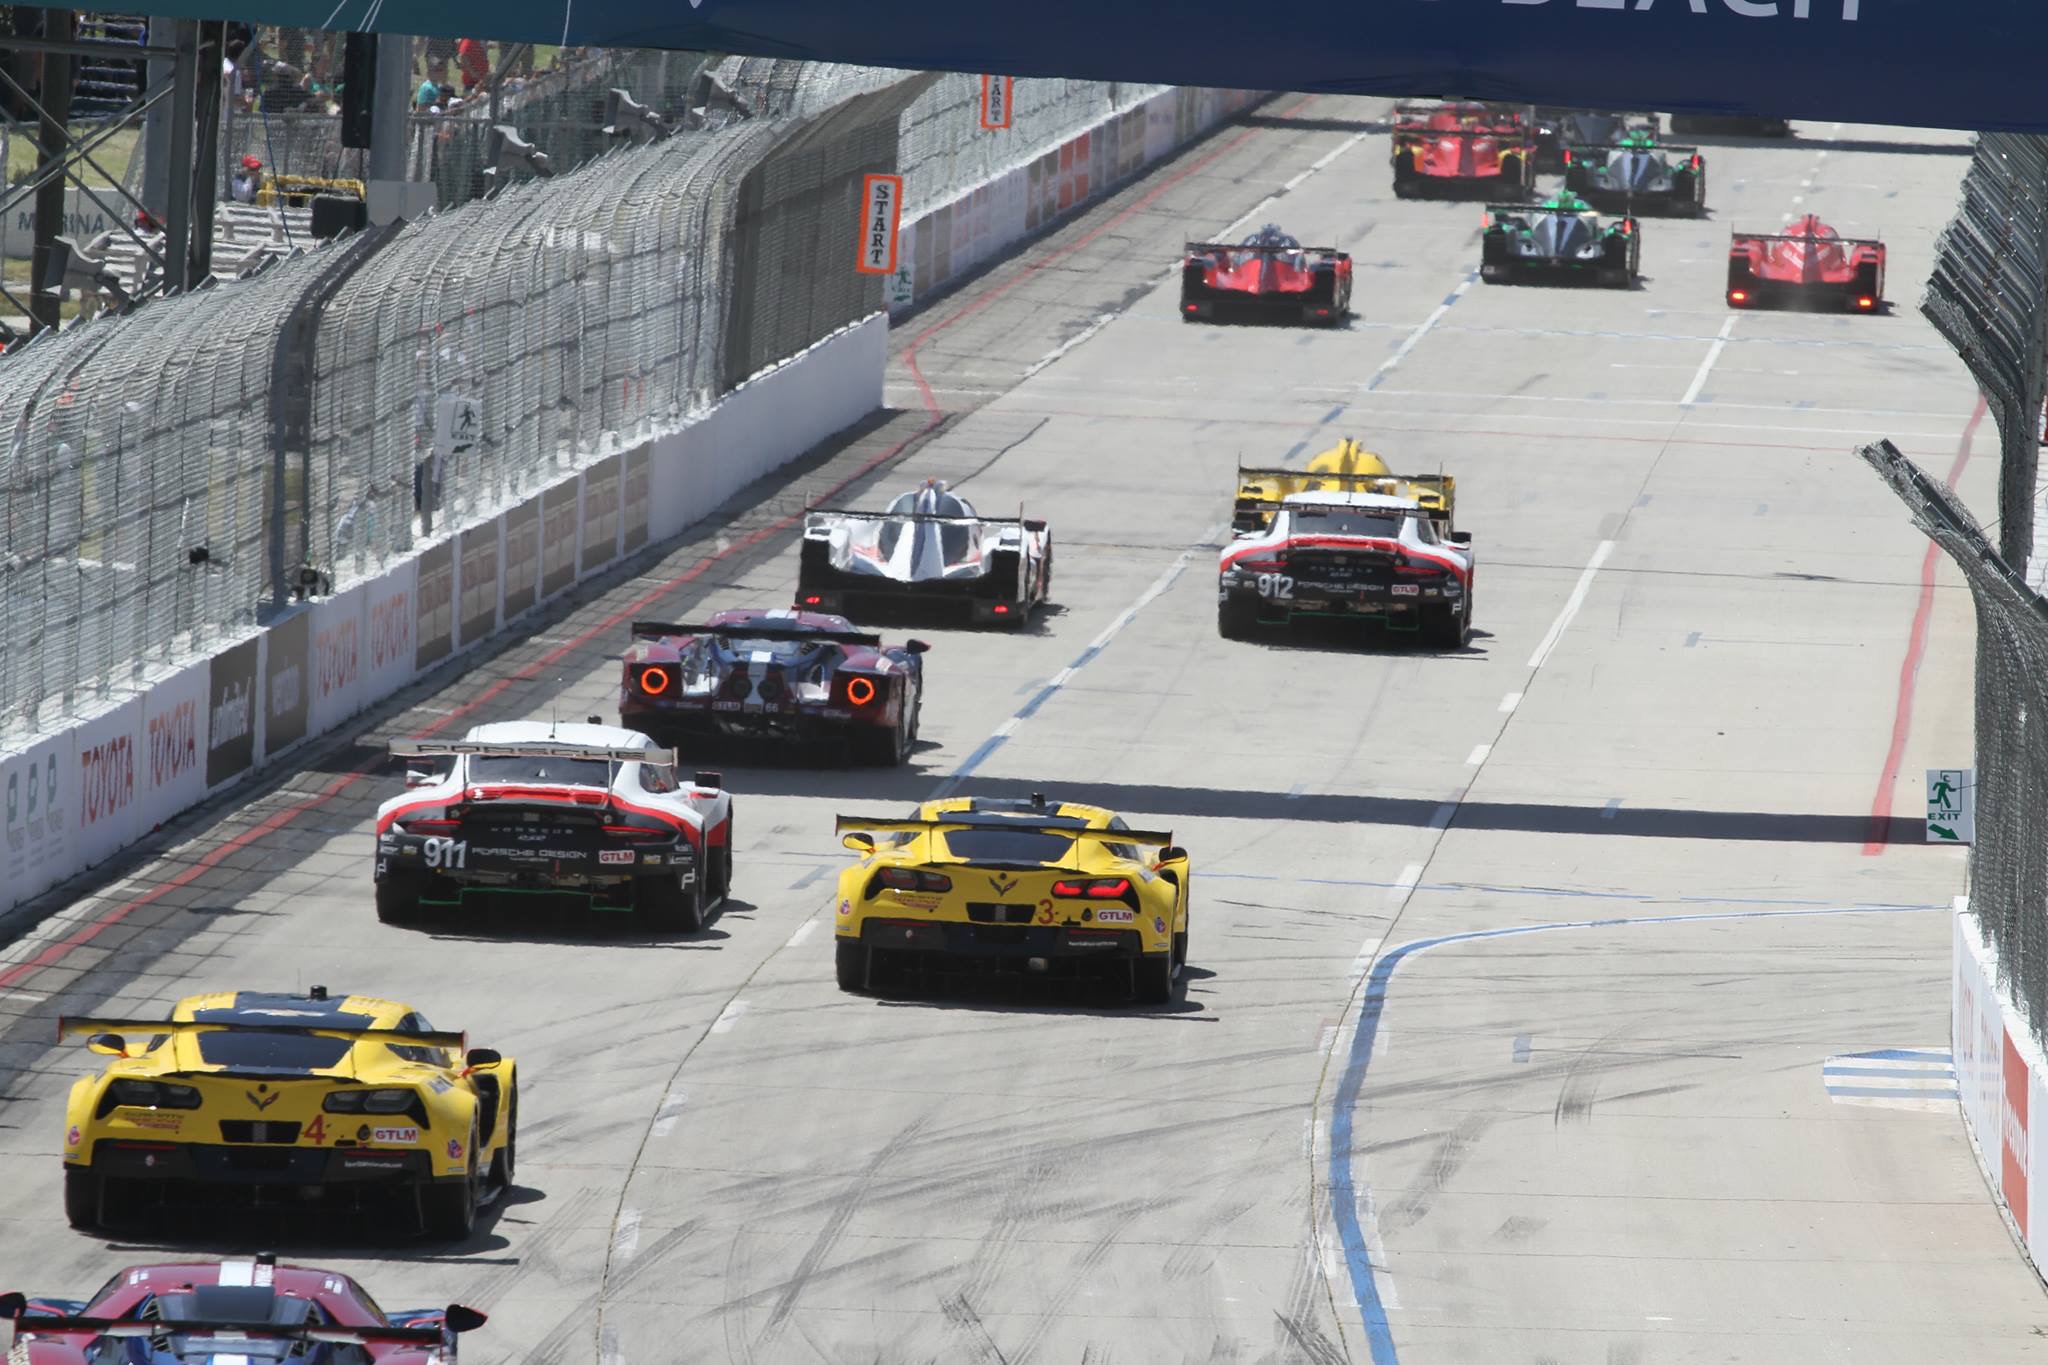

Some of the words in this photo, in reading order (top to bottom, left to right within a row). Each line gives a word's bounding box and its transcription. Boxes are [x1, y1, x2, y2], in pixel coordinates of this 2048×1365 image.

[990, 76, 1002, 122] ART
[18, 212, 104, 234] MINA
[871, 184, 889, 264] START
[1257, 574, 1293, 599] 912
[316, 616, 358, 698] TOYOTA
[149, 698, 196, 788] TOYOTA
[81, 733, 133, 828] TOYOTA
[1928, 812, 1961, 821] EXIT
[423, 838, 467, 869] 911
[472, 847, 534, 858] PORSCHE
[538, 850, 586, 860] DESIGN
[600, 851, 634, 863] GTLM
[1038, 899, 1055, 924] 3
[1099, 911, 1133, 921] GTLM
[304, 1114, 326, 1145] 4
[375, 1129, 416, 1142] GTLM
